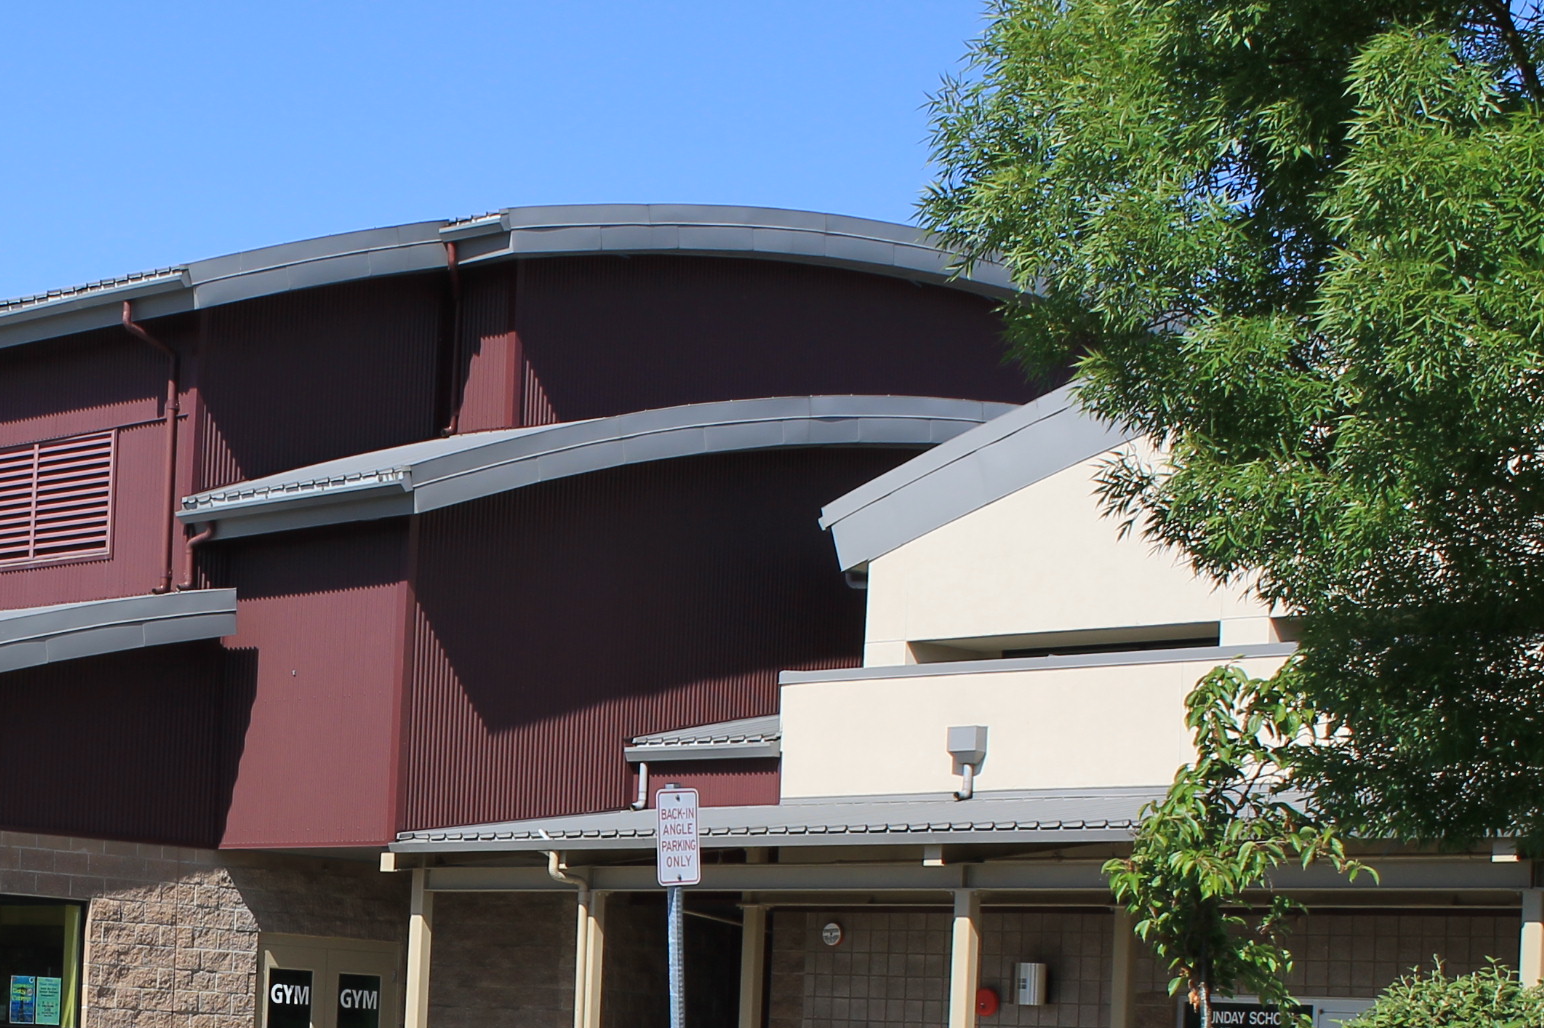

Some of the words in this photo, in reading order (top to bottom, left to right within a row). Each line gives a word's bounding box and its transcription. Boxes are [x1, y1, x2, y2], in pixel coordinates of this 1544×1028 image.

[661, 807, 695, 820] BACK-IN
[663, 823, 693, 836] ANGLE
[662, 839, 696, 852] PARKING
[666, 855, 692, 868] ONLY
[271, 983, 309, 1005] GYM
[340, 989, 378, 1010] GYM
[1209, 1011, 1245, 1024] UNDAY
[1249, 1011, 1298, 1026] SCHOL
